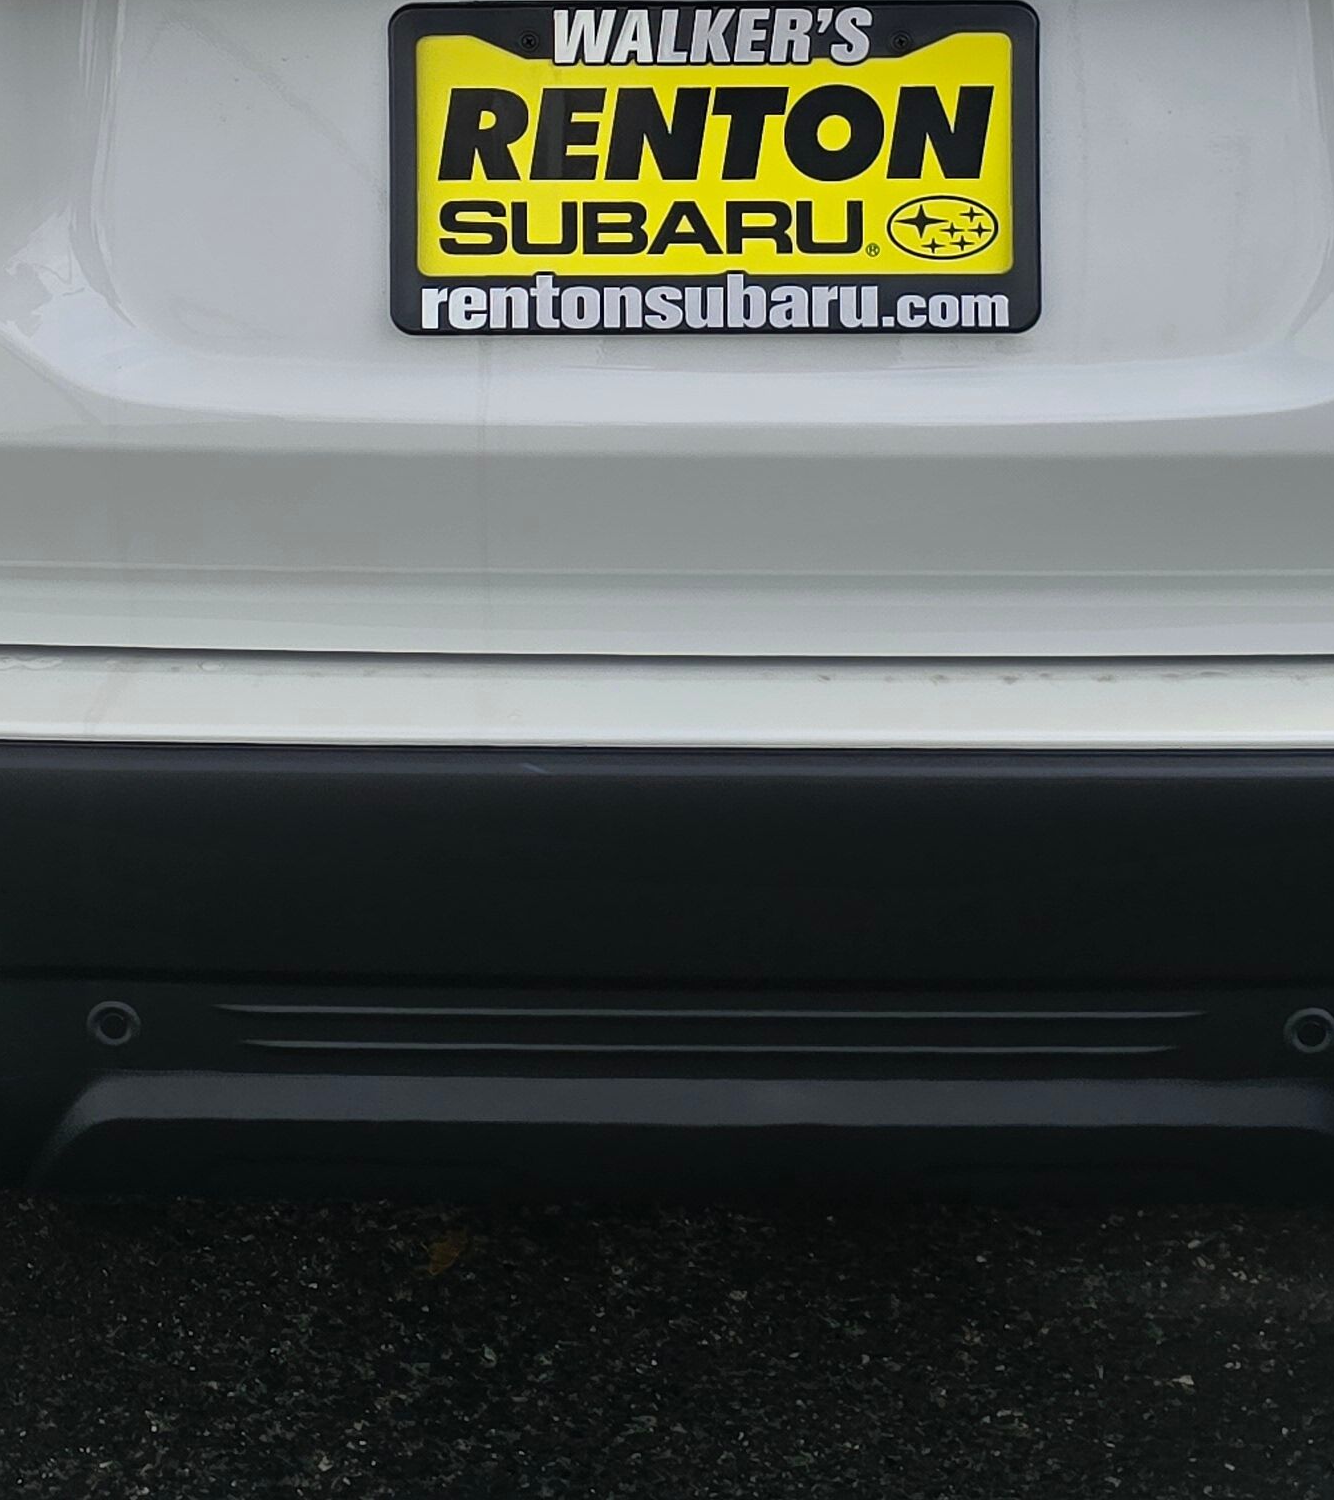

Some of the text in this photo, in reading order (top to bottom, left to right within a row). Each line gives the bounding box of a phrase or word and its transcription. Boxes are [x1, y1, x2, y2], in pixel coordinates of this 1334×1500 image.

[552, 6, 872, 65] WALKER'S
[438, 84, 994, 181] RENTON
[439, 200, 865, 255] SUBARU
[420, 273, 1009, 330] rentonsubaru.com
